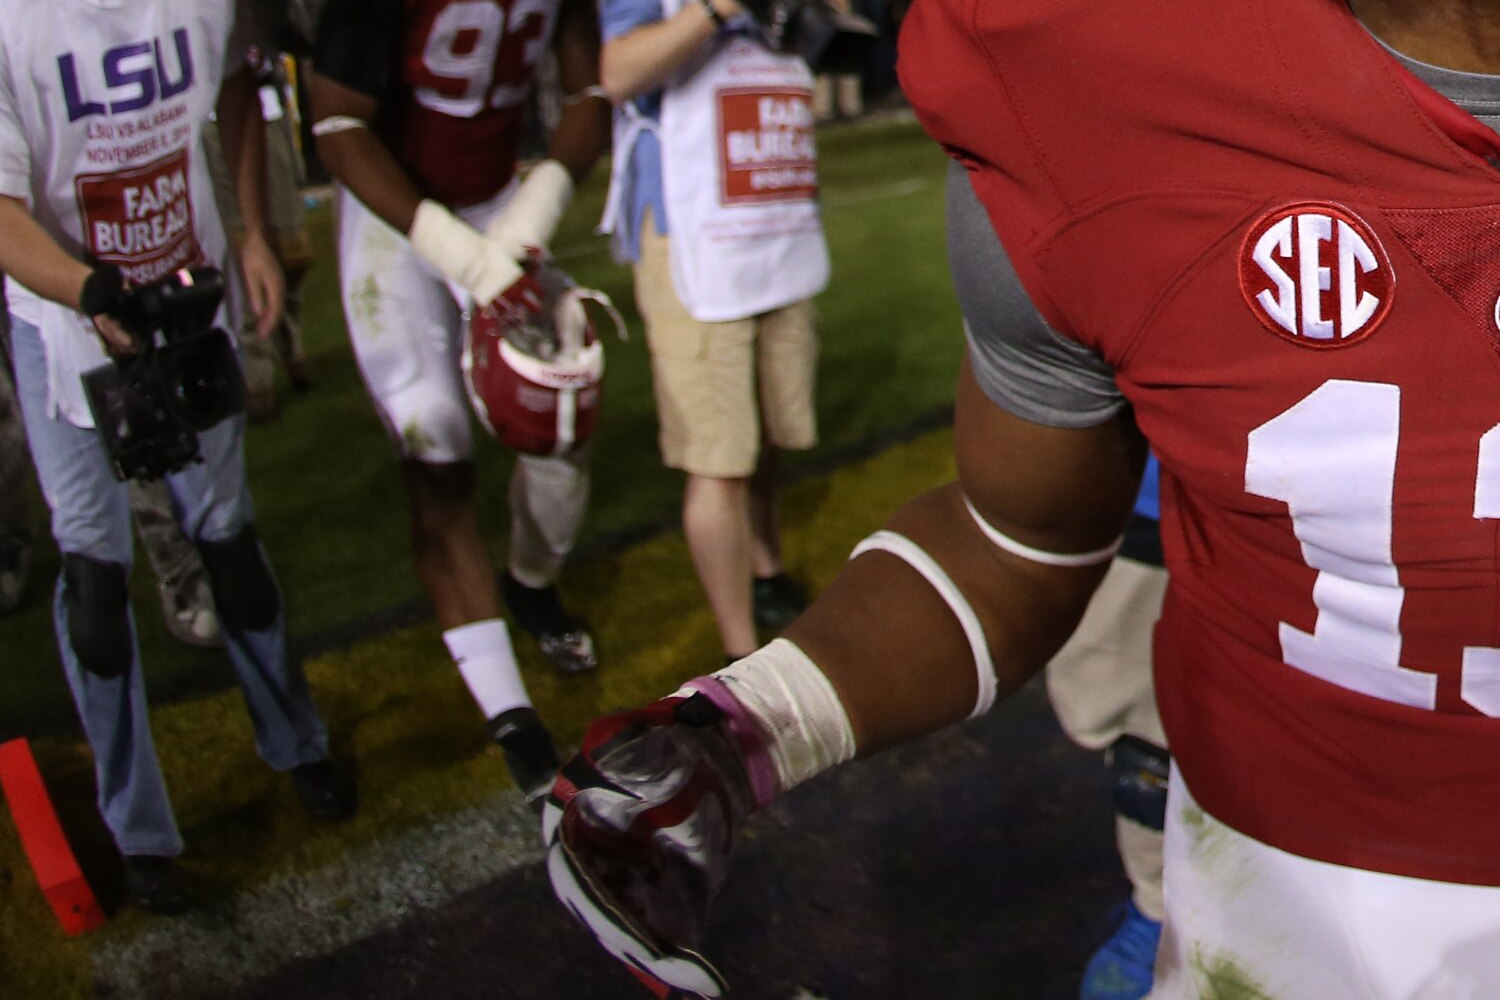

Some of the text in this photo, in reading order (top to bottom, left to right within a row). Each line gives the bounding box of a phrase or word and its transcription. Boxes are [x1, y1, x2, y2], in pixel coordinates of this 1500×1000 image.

[57, 26, 195, 123] LSU
[94, 195, 189, 255] BUREAU
[123, 167, 186, 220] FARM
[1252, 211, 1381, 340] SEC
